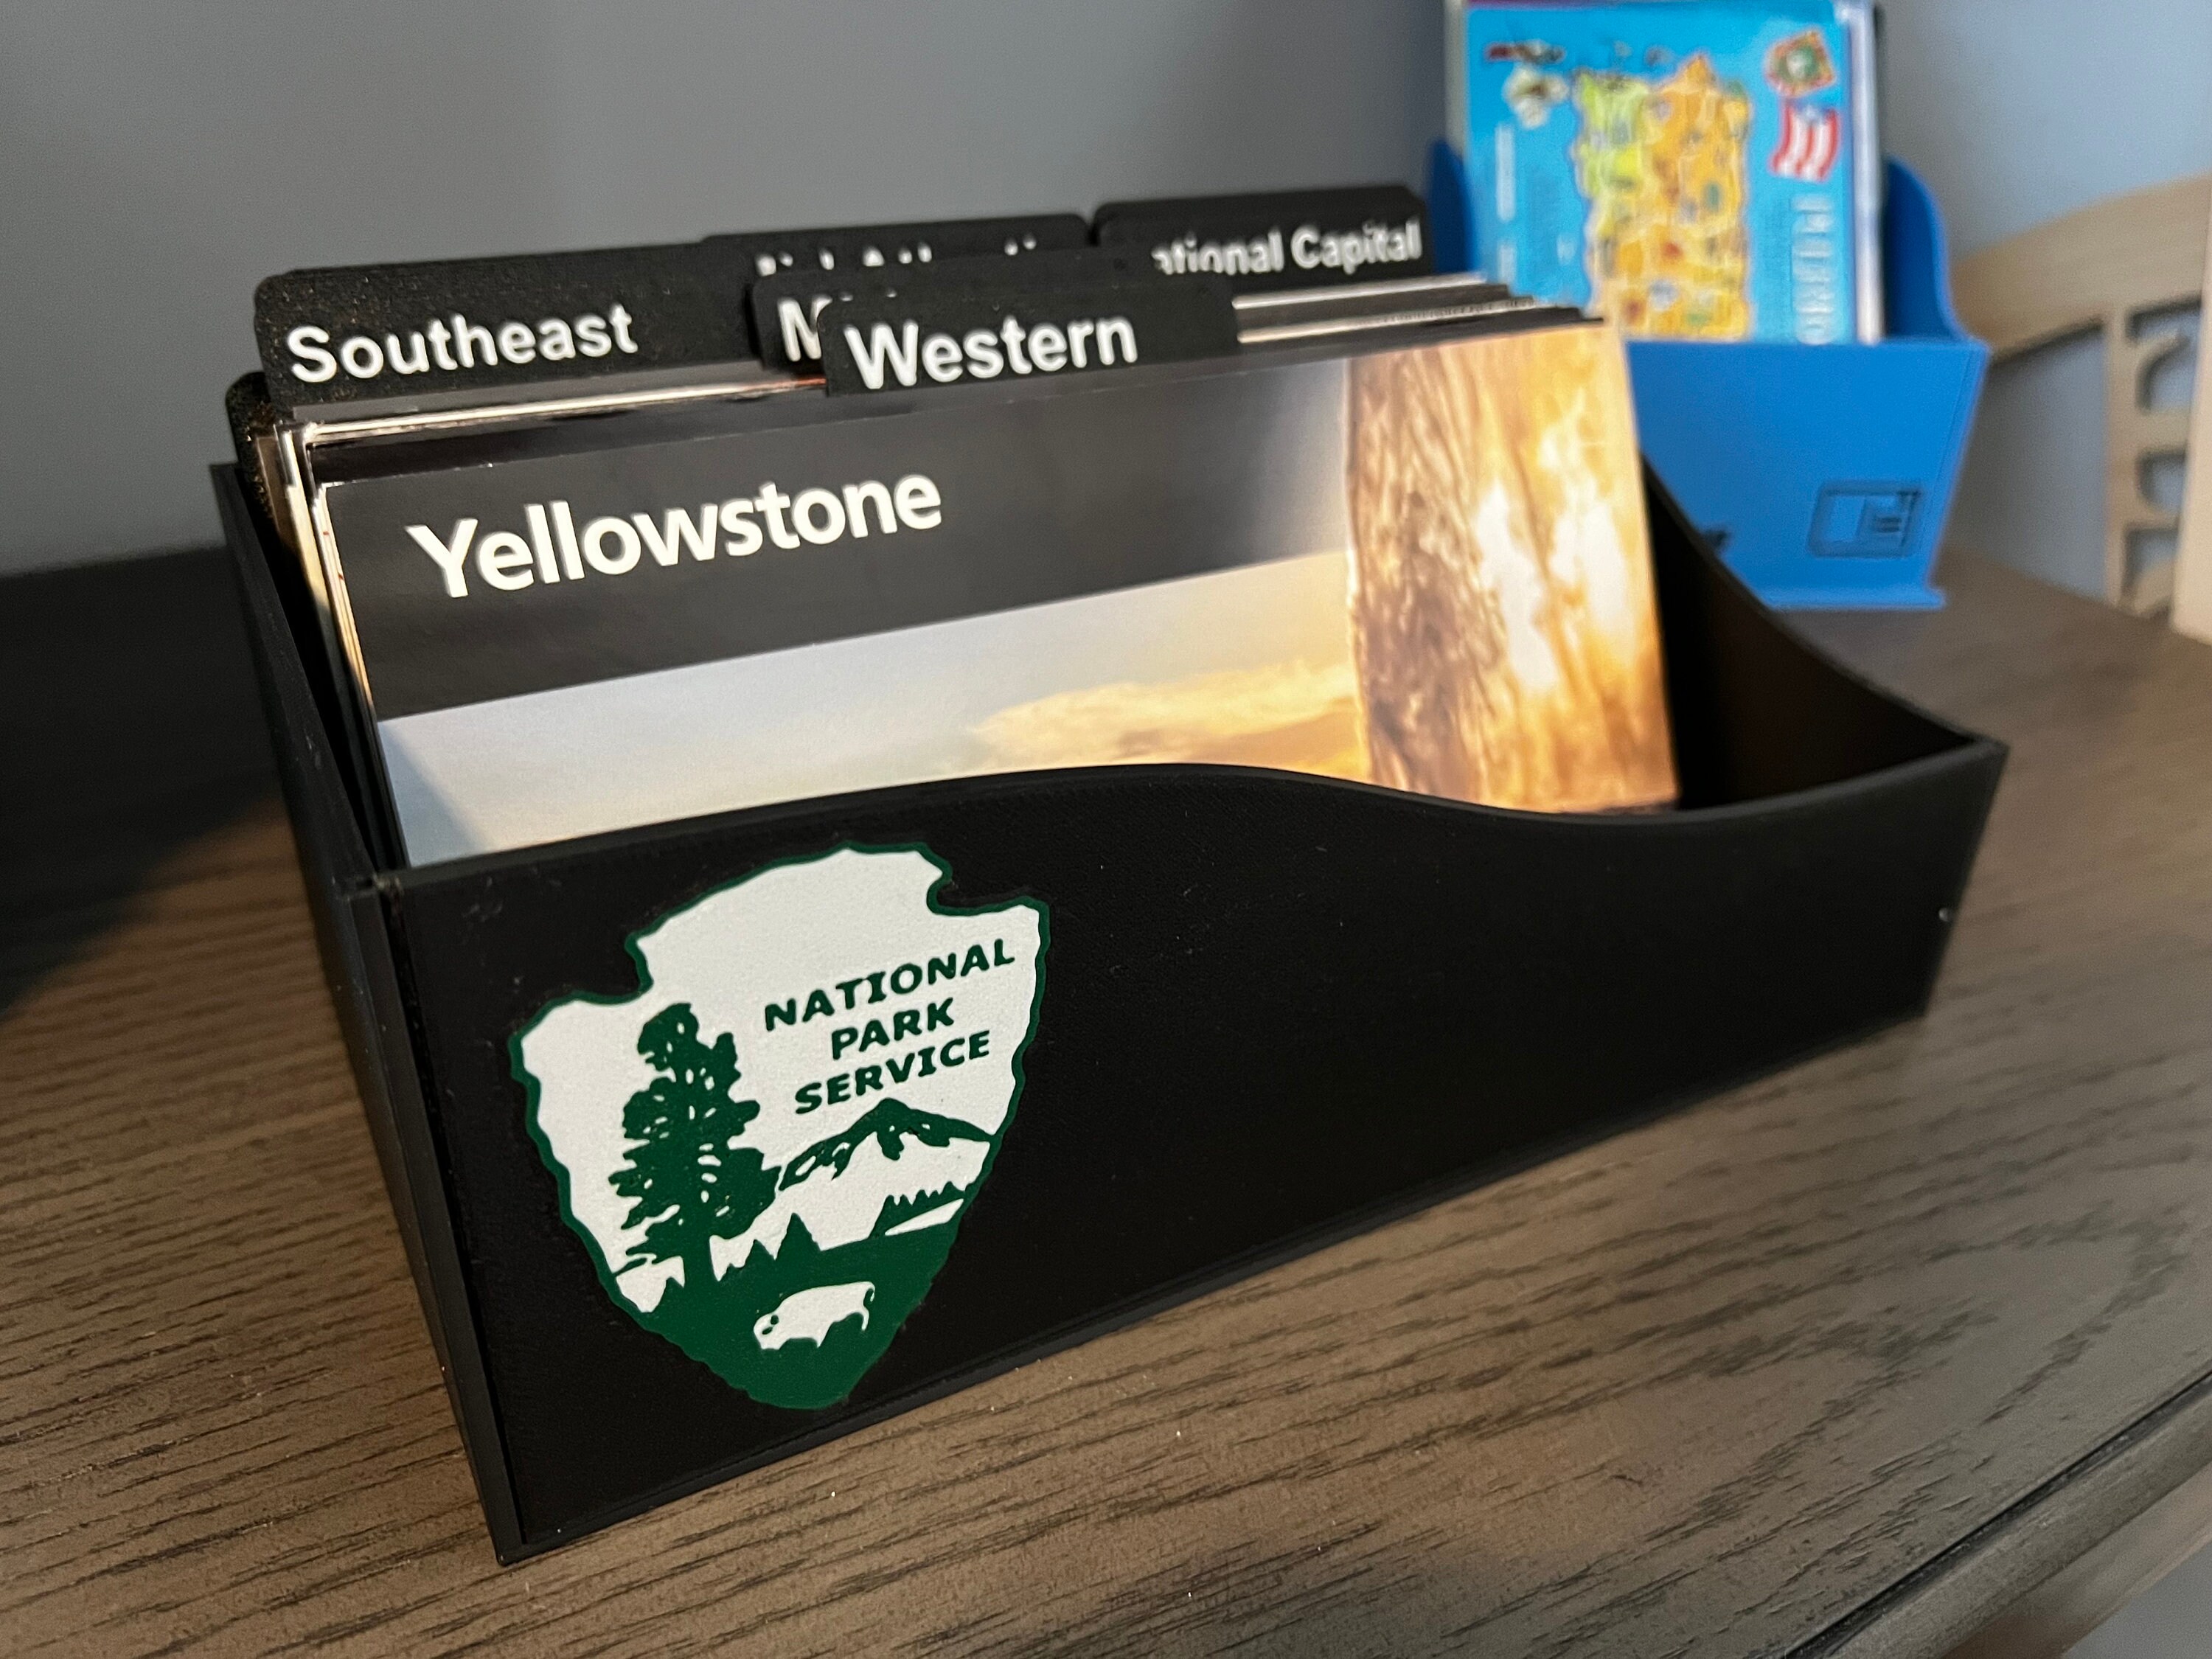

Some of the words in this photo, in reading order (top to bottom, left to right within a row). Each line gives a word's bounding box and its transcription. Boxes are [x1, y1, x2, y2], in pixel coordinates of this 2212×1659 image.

[1150, 229, 1284, 276] ational
[1290, 216, 1423, 275] Capital
[286, 304, 639, 383] Southeast
[844, 316, 1138, 390] Western
[406, 473, 942, 599] Yellowstone
[764, 938, 1016, 1032] NATIONAL
[830, 996, 955, 1061] PARK
[794, 1029, 991, 1115] SERVICE
